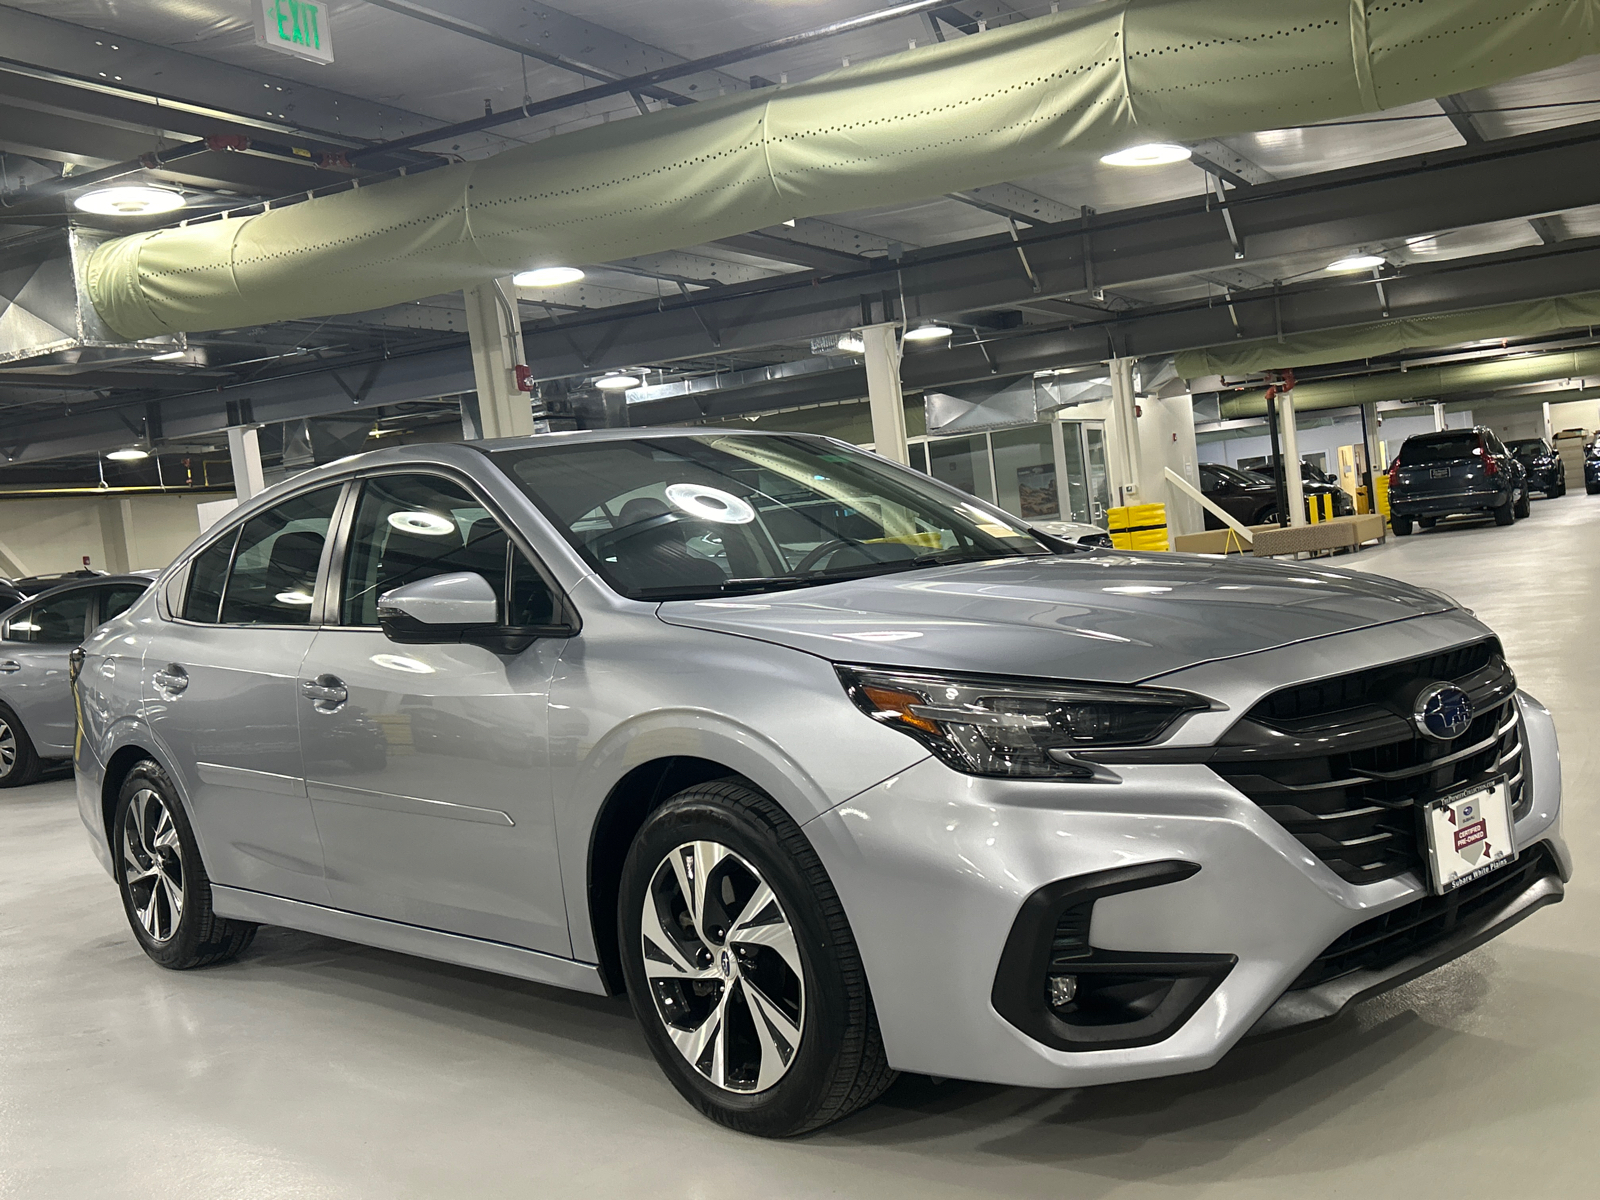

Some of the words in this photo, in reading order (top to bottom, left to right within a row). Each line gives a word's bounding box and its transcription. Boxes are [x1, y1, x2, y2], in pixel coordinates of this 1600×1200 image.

[275, 0, 320, 50] EXIT
[1457, 831, 1483, 846] PRE-OWNED
[1459, 825, 1481, 838] CERTIFIED
[1451, 875, 1472, 889] Subaru
[1472, 867, 1489, 880] White
[1490, 859, 1507, 870] Plains
